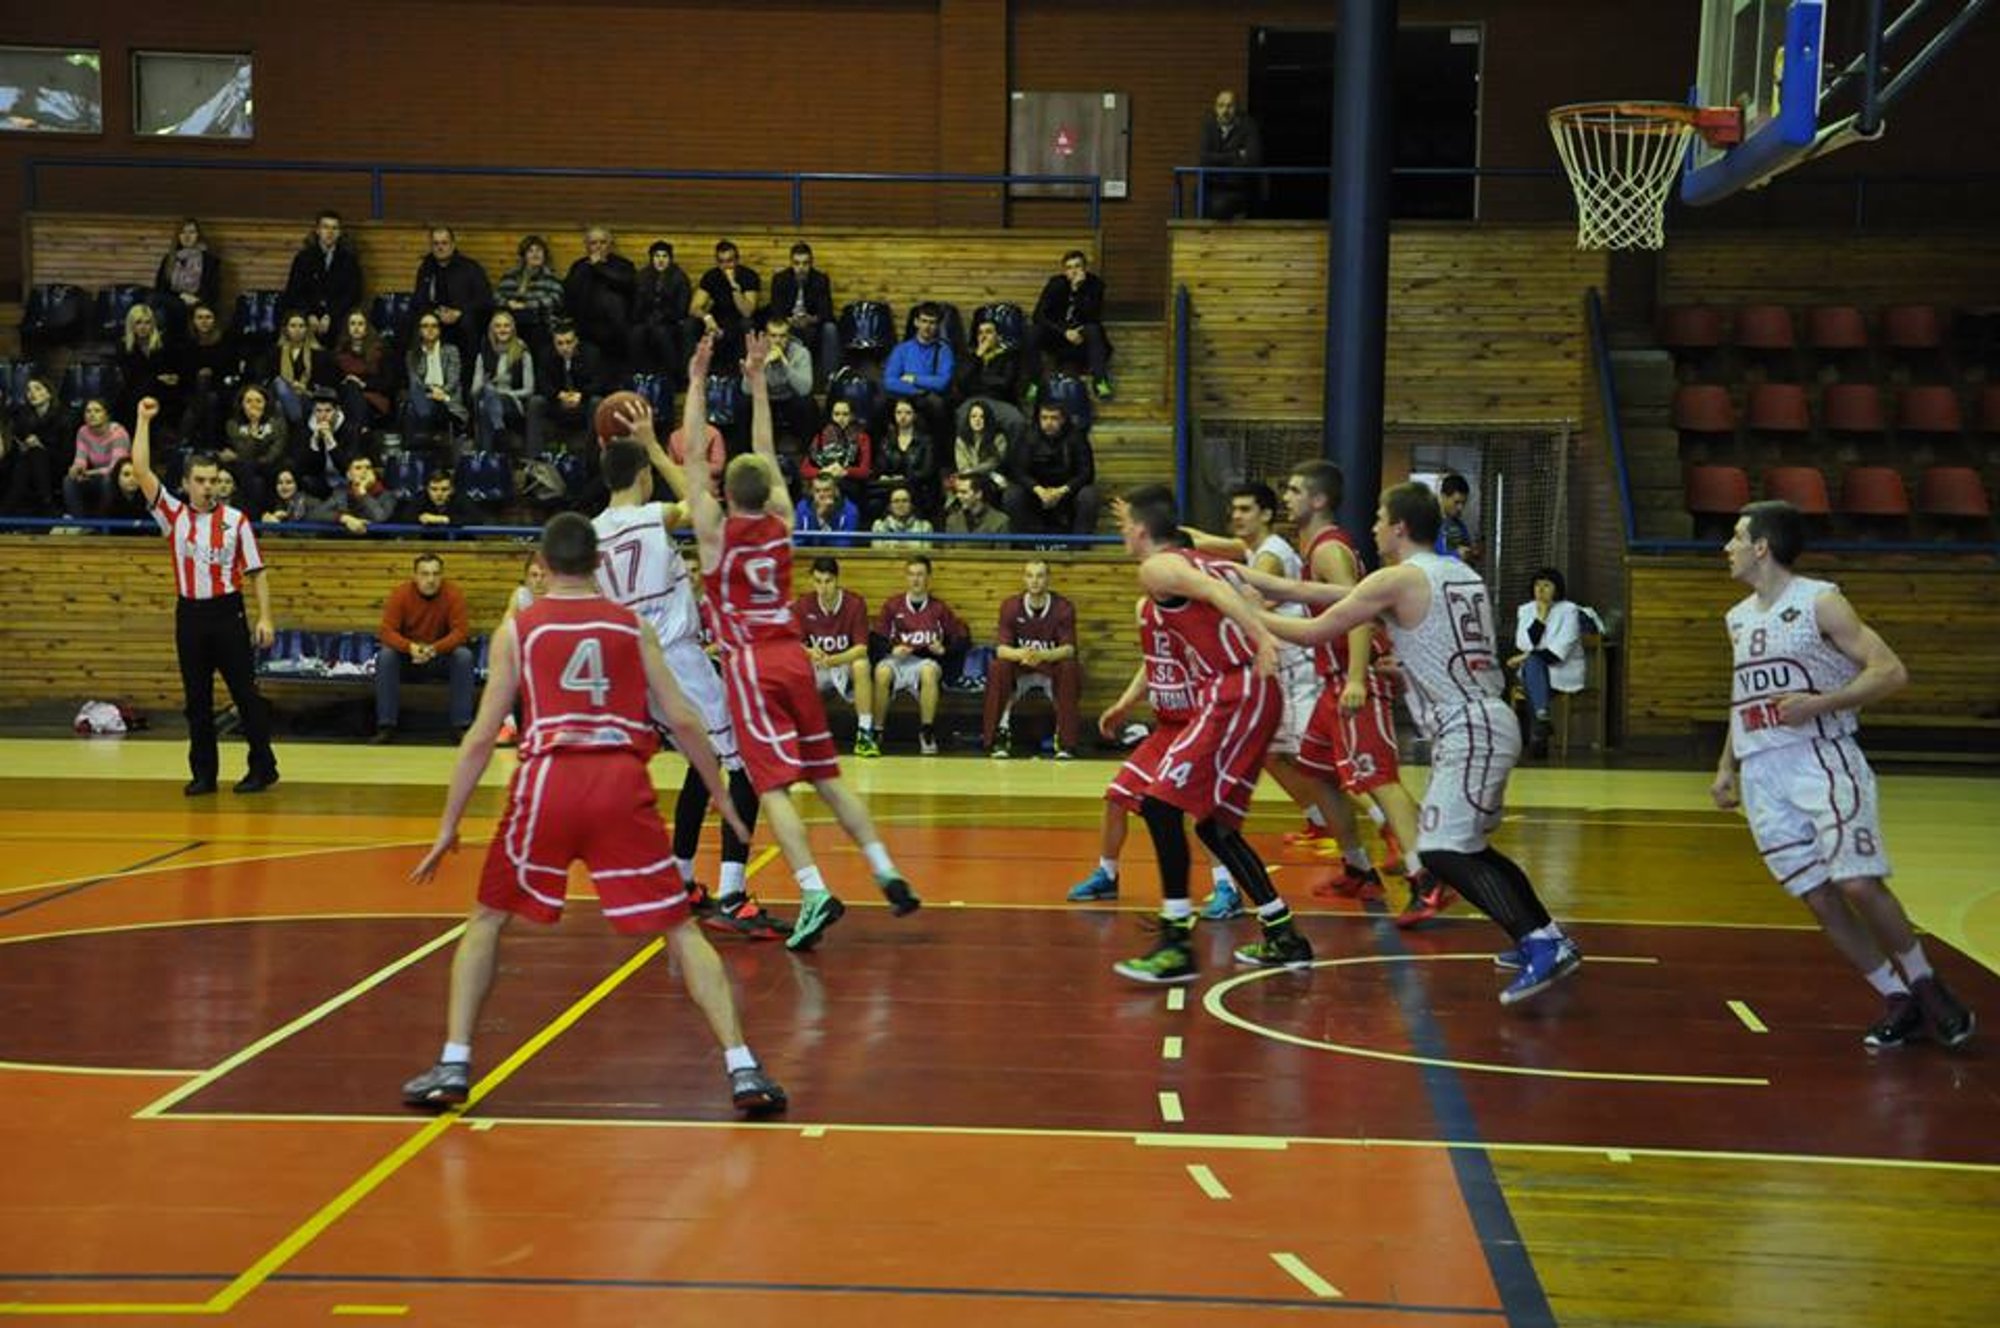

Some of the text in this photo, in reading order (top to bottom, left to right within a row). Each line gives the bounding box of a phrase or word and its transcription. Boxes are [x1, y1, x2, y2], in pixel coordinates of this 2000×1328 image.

[1750, 628, 1767, 656] 8
[560, 638, 610, 706] 4
[1738, 666, 1791, 693] VDU
[1853, 827, 1876, 856] 8
